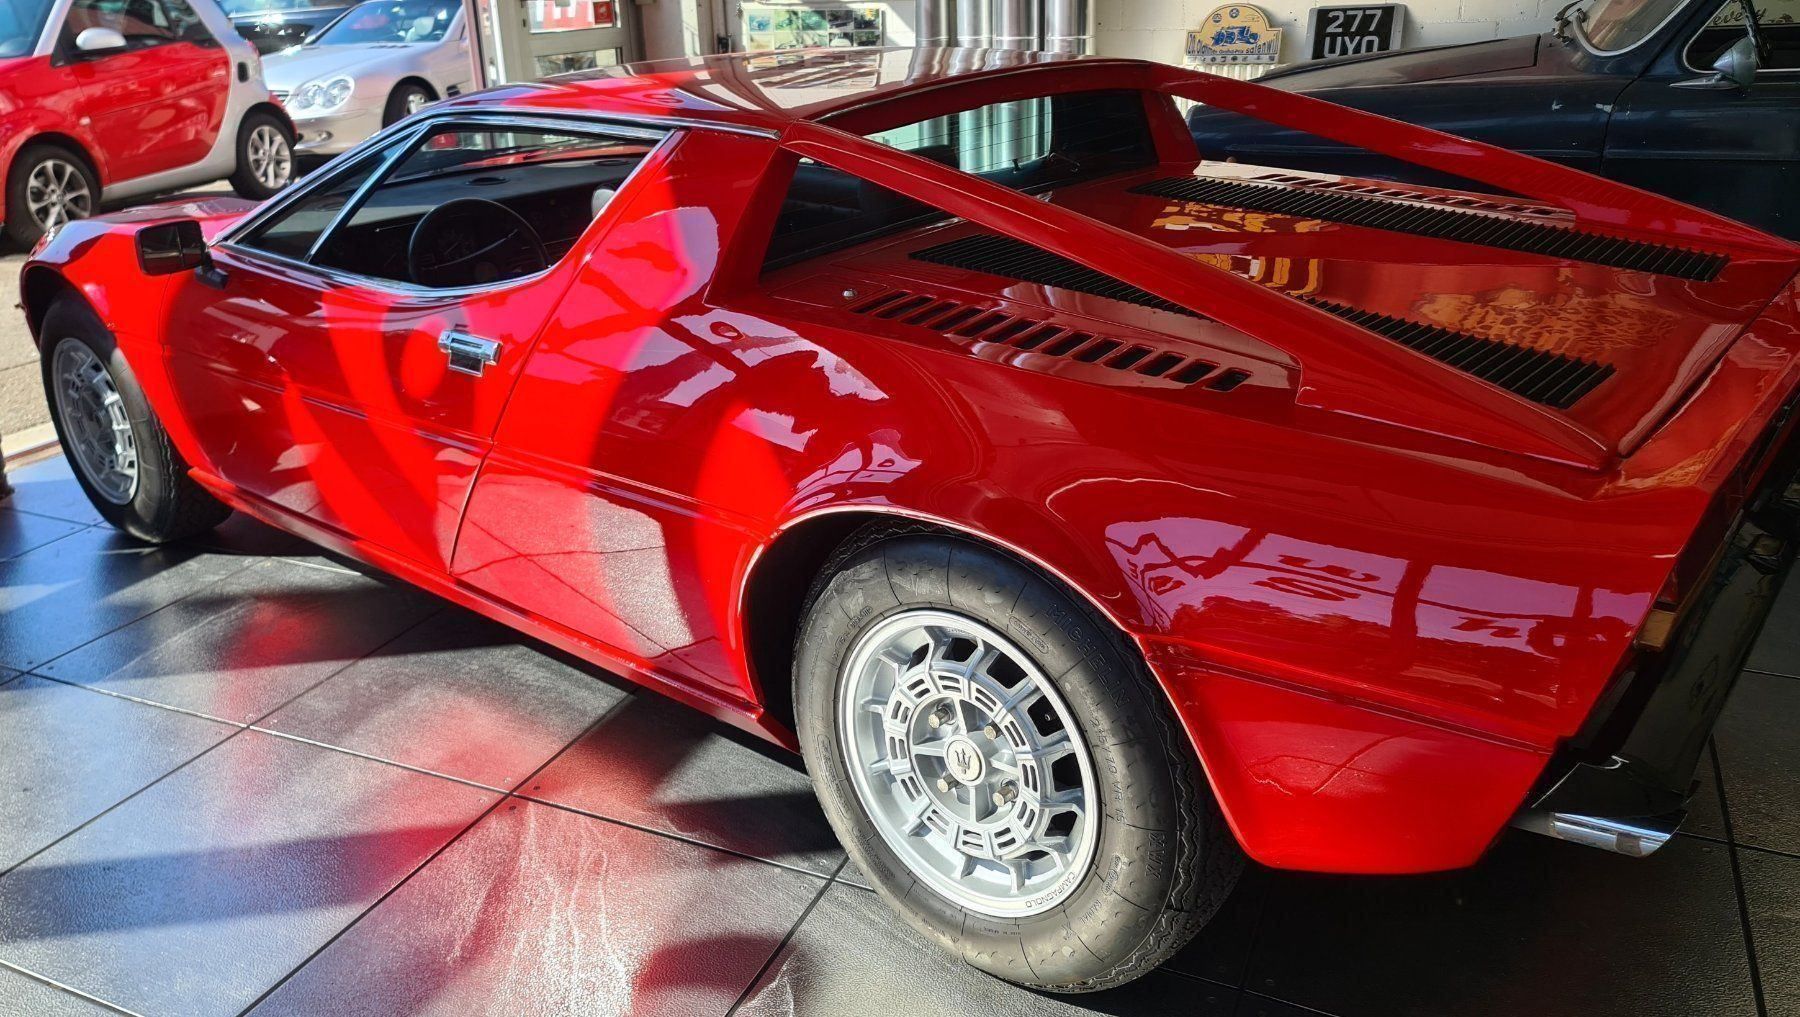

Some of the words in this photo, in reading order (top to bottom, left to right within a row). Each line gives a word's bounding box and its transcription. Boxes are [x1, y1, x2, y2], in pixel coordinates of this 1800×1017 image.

[1325, 9, 1383, 33] 277
[1323, 35, 1379, 58] UYO
[1044, 602, 1131, 712] MICHELIN
[1144, 832, 1166, 880] XWX
[1024, 871, 1077, 908] CAMPAGNOLO
